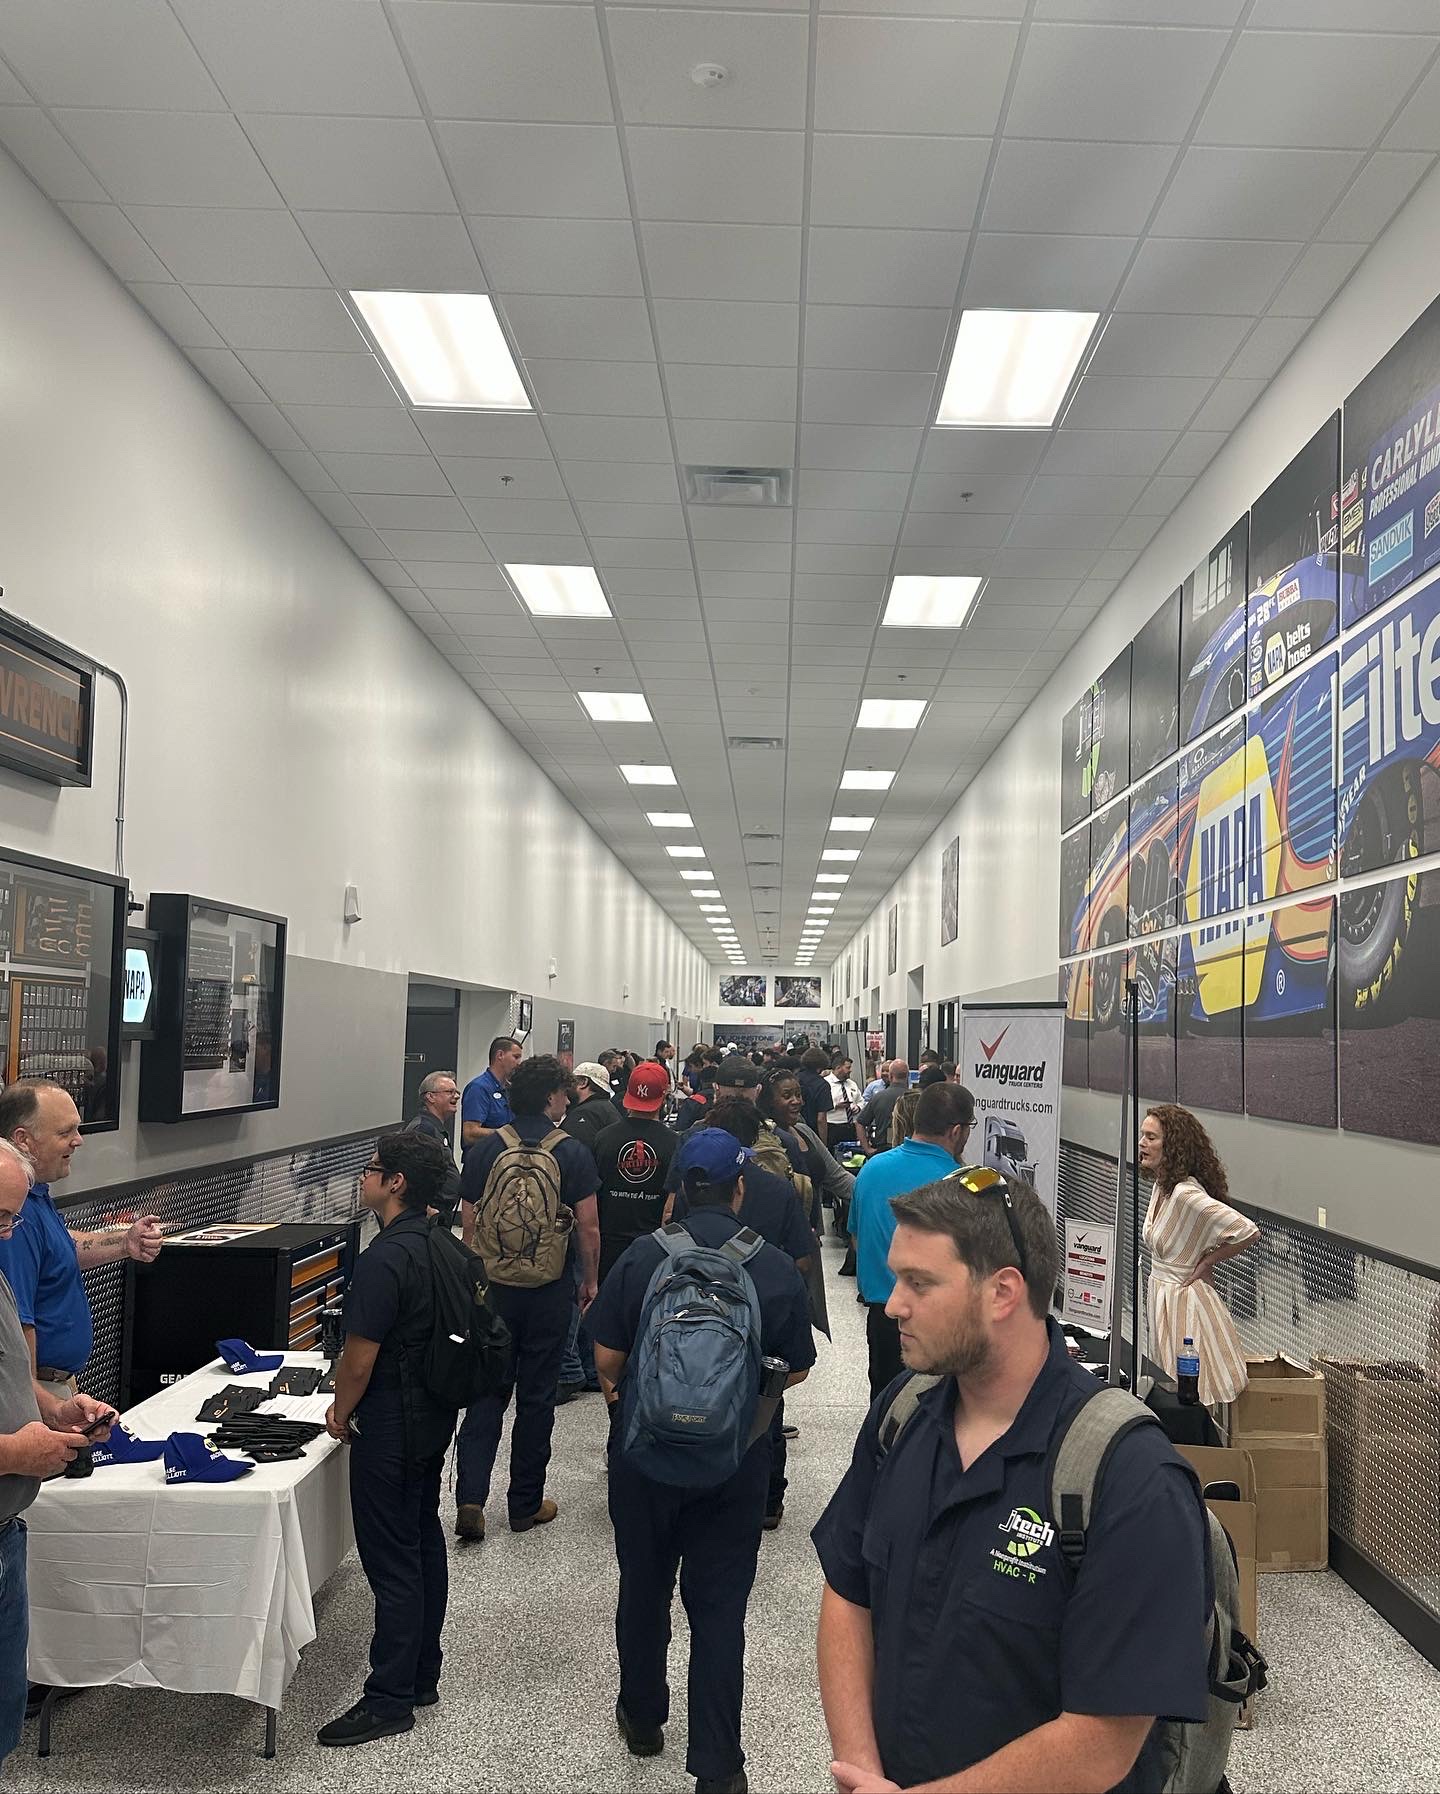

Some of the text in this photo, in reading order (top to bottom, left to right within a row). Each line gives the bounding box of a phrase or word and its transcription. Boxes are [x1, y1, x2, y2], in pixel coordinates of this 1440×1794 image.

[1368, 461, 1418, 521] PROFESSIONAL
[1370, 515, 1412, 563] SANDVIK
[1286, 621, 1311, 651] belts
[1267, 644, 1284, 675] NAPA
[1287, 643, 1312, 671] hose
[1200, 793, 1263, 946] NAPA
[975, 1061, 1046, 1085] vanguard
[1023, 1081, 1043, 1089] CENTERS
[975, 1097, 1053, 1114] nguardtrucks.com
[1073, 1242, 1102, 1253] vanguard
[1016, 1532, 1044, 1546] INSTITUTE
[993, 1559, 1021, 1578] HVAC
[1028, 1572, 1036, 1584] R
